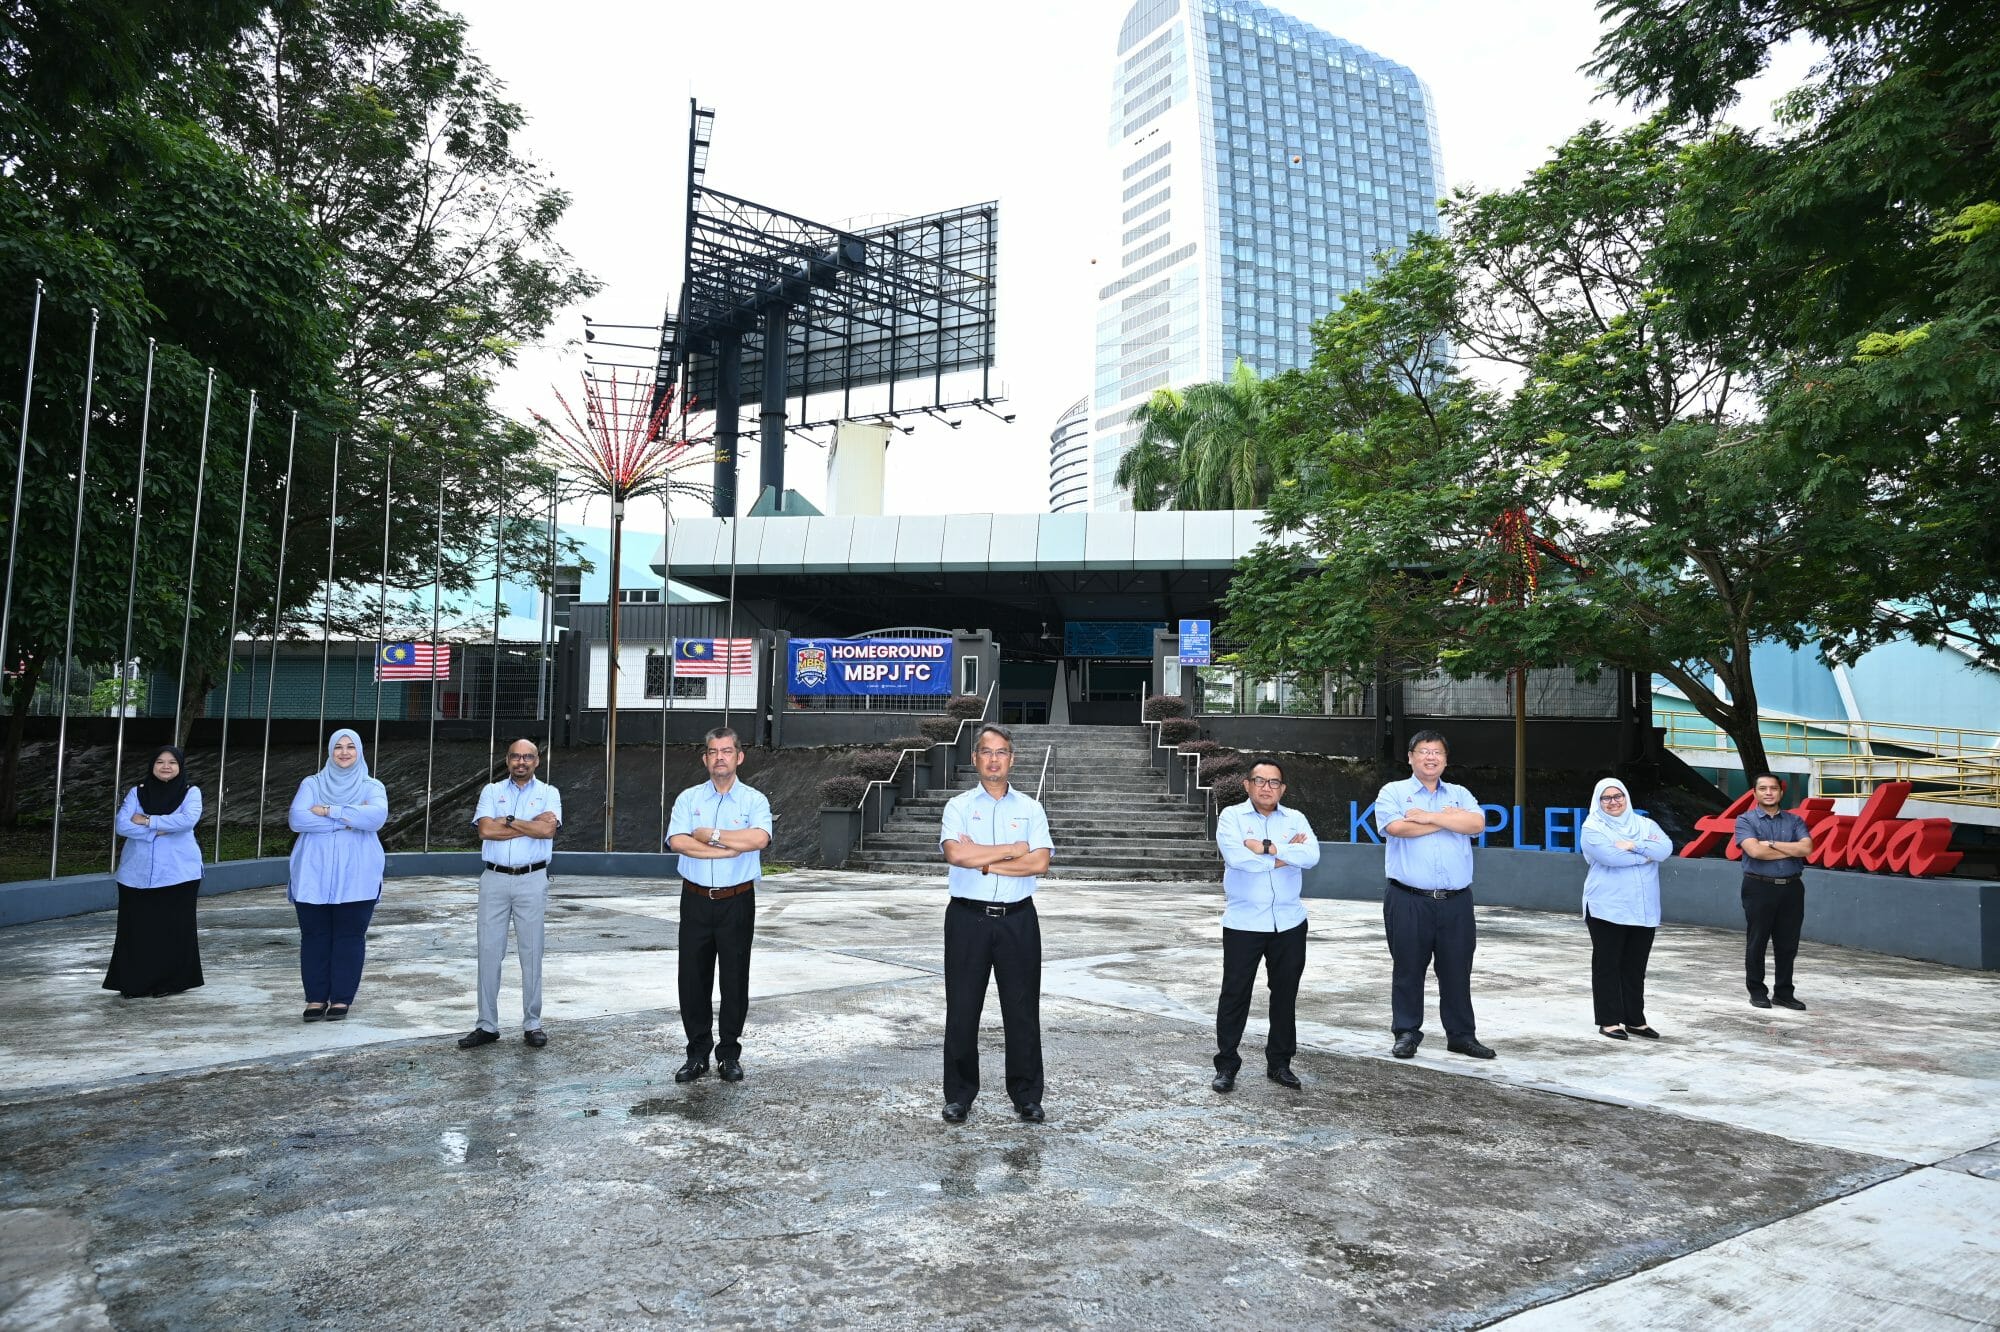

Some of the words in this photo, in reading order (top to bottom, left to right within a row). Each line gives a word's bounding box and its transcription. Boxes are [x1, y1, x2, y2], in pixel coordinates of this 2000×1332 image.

[832, 645, 944, 659] HOMEGROUND
[844, 664, 901, 681] MBPJ
[904, 664, 931, 681] FC
[1350, 800, 1650, 854] KPLE
